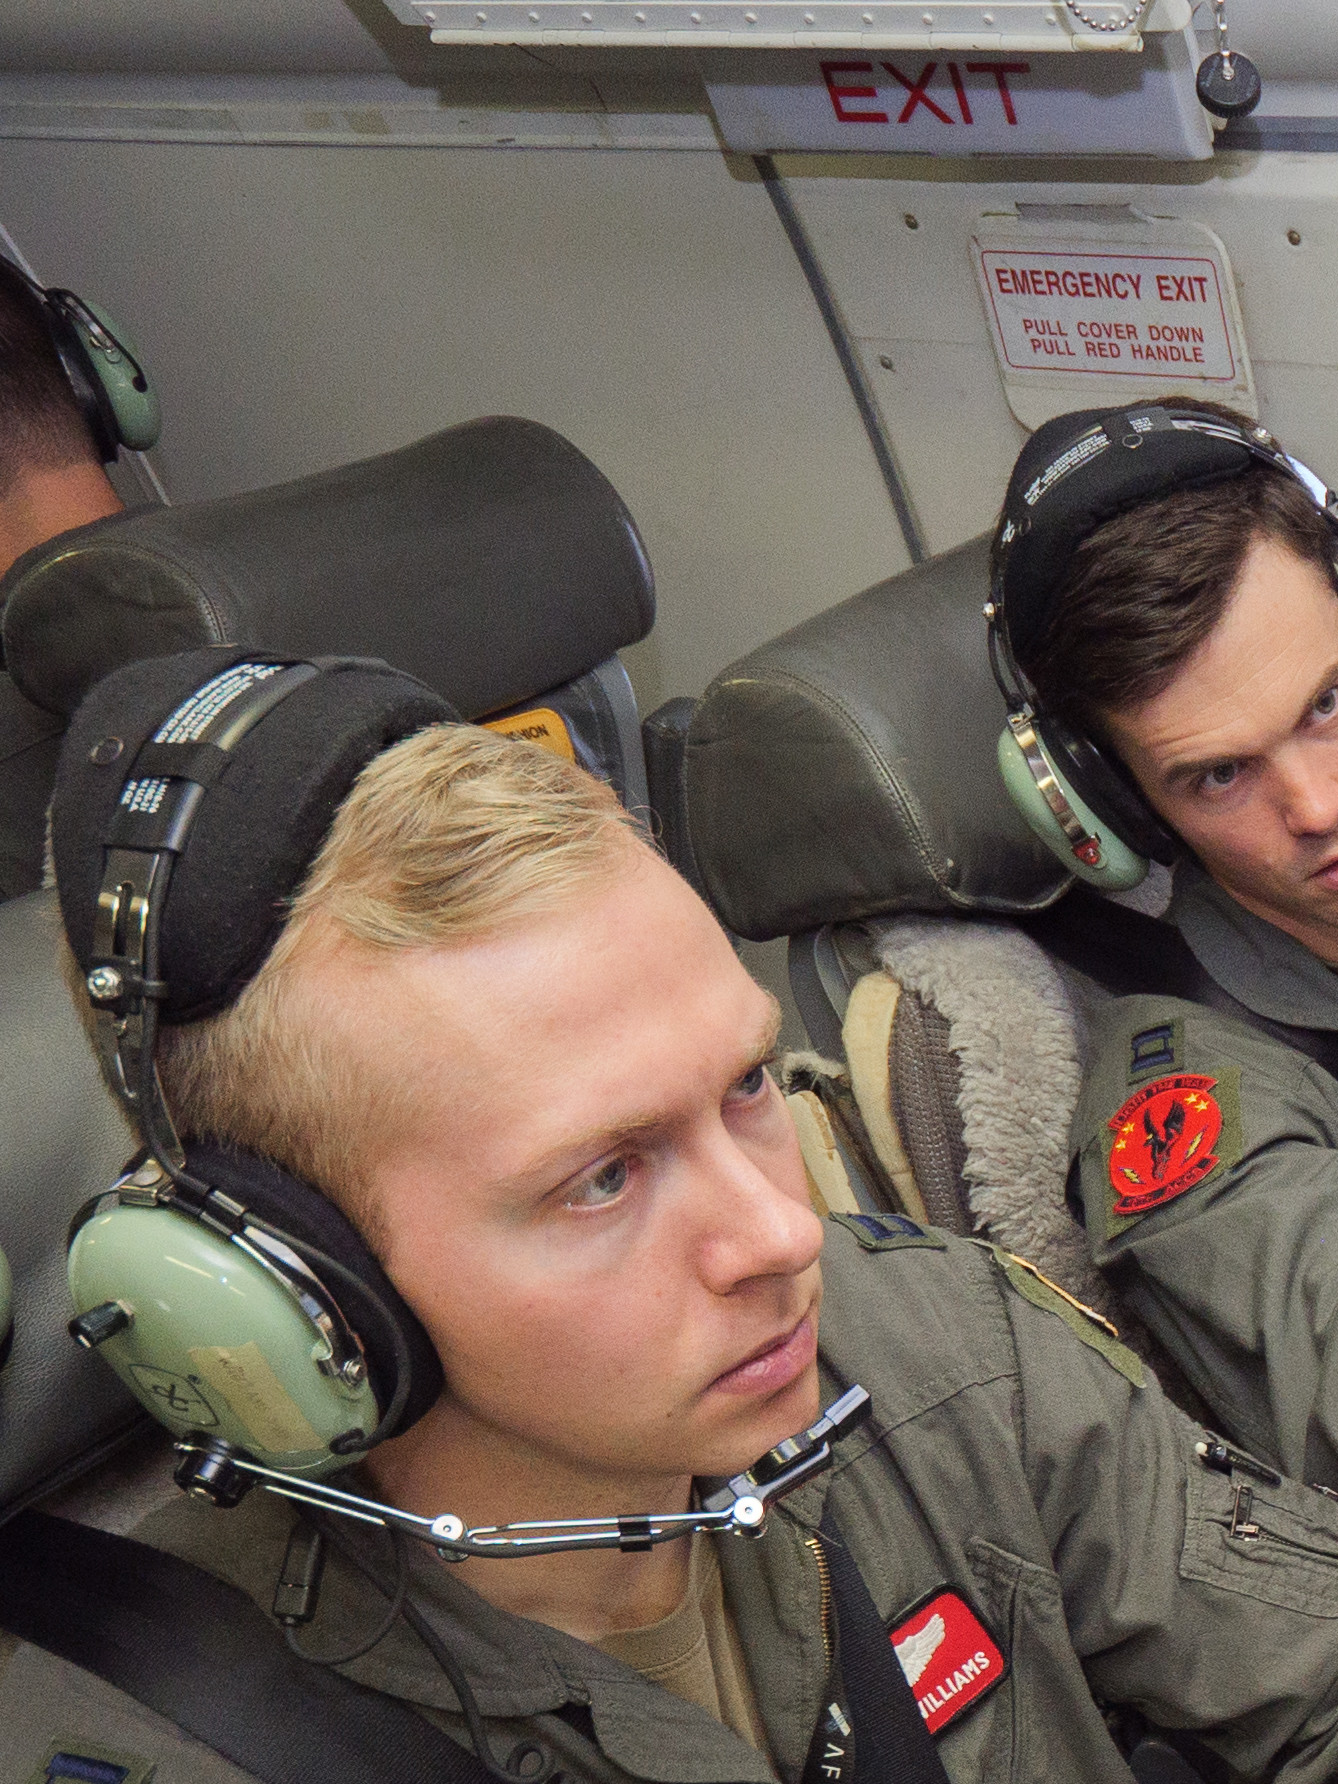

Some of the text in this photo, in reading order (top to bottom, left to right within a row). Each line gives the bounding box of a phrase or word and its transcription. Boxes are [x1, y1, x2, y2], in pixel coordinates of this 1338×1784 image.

[819, 61, 1030, 125] EXIT
[995, 268, 1208, 302] EMERGENCY EXIT
[1023, 318, 1204, 343] PULL COVER DOWN
[1031, 338, 1205, 363] PULL RED HANDLE
[918, 1652, 990, 1719] ILLIAMS
